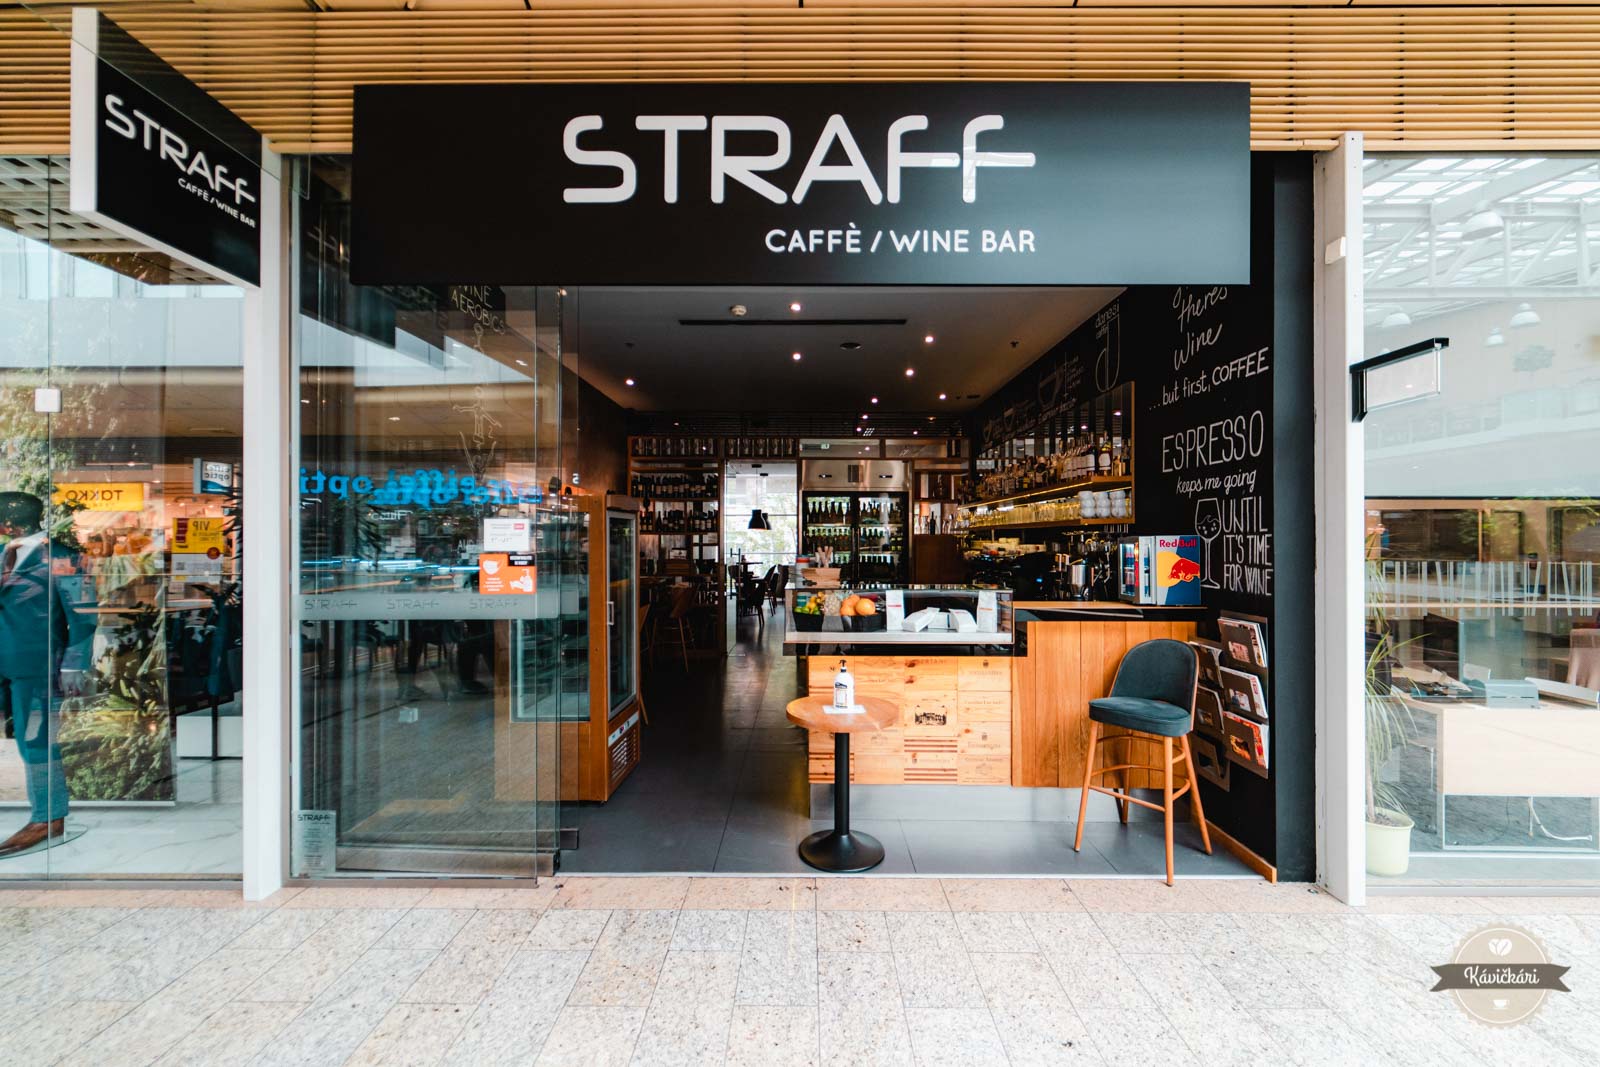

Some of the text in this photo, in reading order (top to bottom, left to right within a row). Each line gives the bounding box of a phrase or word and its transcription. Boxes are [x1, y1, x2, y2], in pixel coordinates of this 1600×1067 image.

[105, 94, 255, 205] STRAFF
[563, 114, 1036, 204] STRAFF
[178, 178, 209, 202] CAFFÈ
[215, 198, 239, 219] WINE
[240, 213, 255, 228] BAR
[764, 222, 861, 253] CAFFÈ
[890, 229, 969, 253] WINE
[981, 229, 1036, 253] BAR
[451, 289, 505, 335] AEROBICS
[459, 285, 493, 309] INE
[1212, 346, 1269, 386] COFFEE
[1162, 410, 1264, 473] ESPRESSO
[1176, 469, 1257, 499] keeps me going
[1222, 496, 1268, 533] UNTIL
[1159, 538, 1197, 548] Red Bull
[1223, 533, 1273, 566] IT'S TIME
[1223, 564, 1274, 596] FOR WINE
